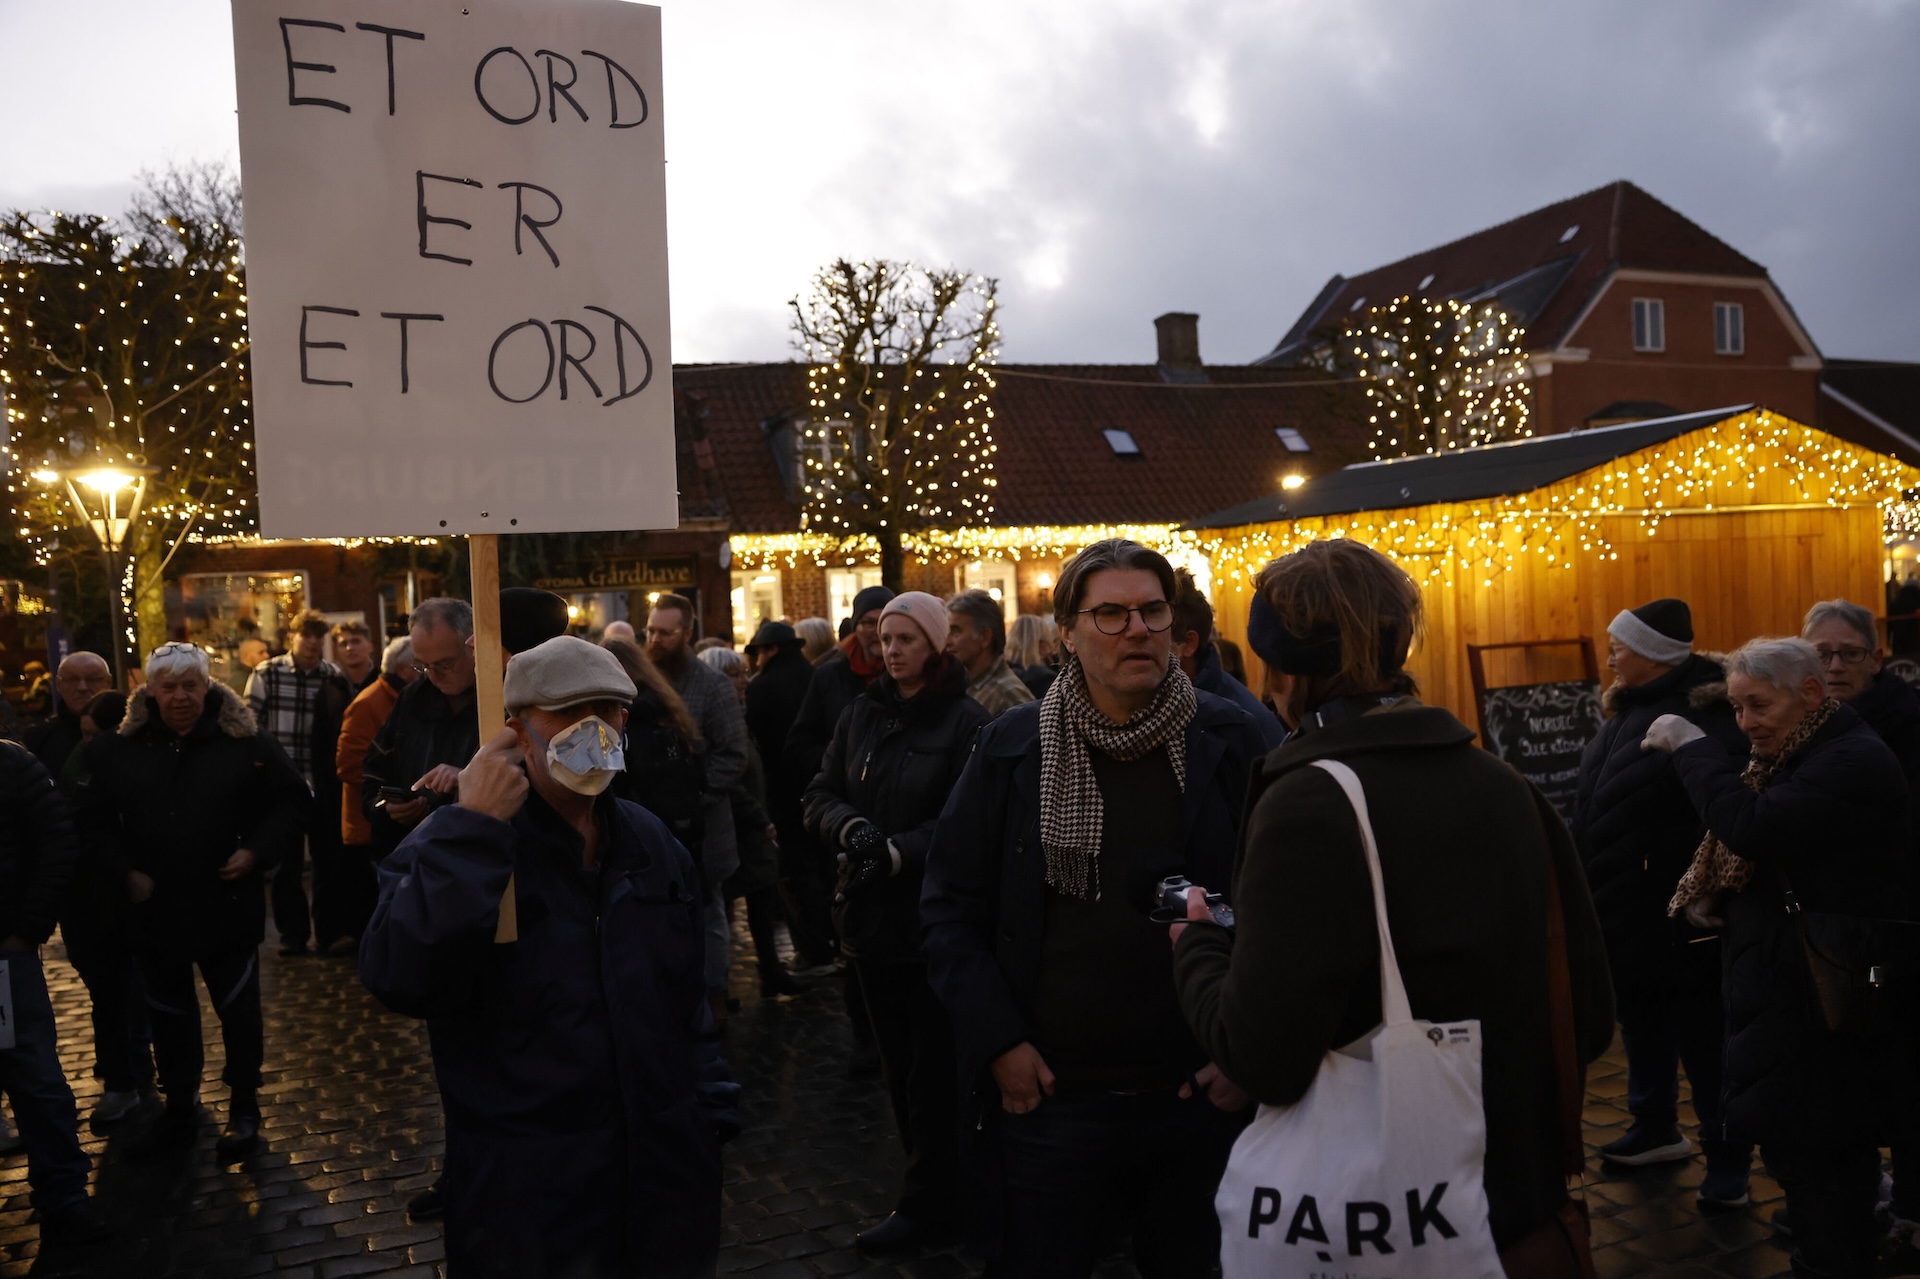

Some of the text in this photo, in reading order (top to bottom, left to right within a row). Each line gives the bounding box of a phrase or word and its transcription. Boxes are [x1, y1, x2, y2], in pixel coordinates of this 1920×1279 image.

[279, 17, 649, 129] ET ORD
[417, 170, 563, 268] ER
[299, 305, 654, 407] ET ORD
[588, 560, 690, 588] Gårdhave
[1248, 1181, 1459, 1262] PARK
